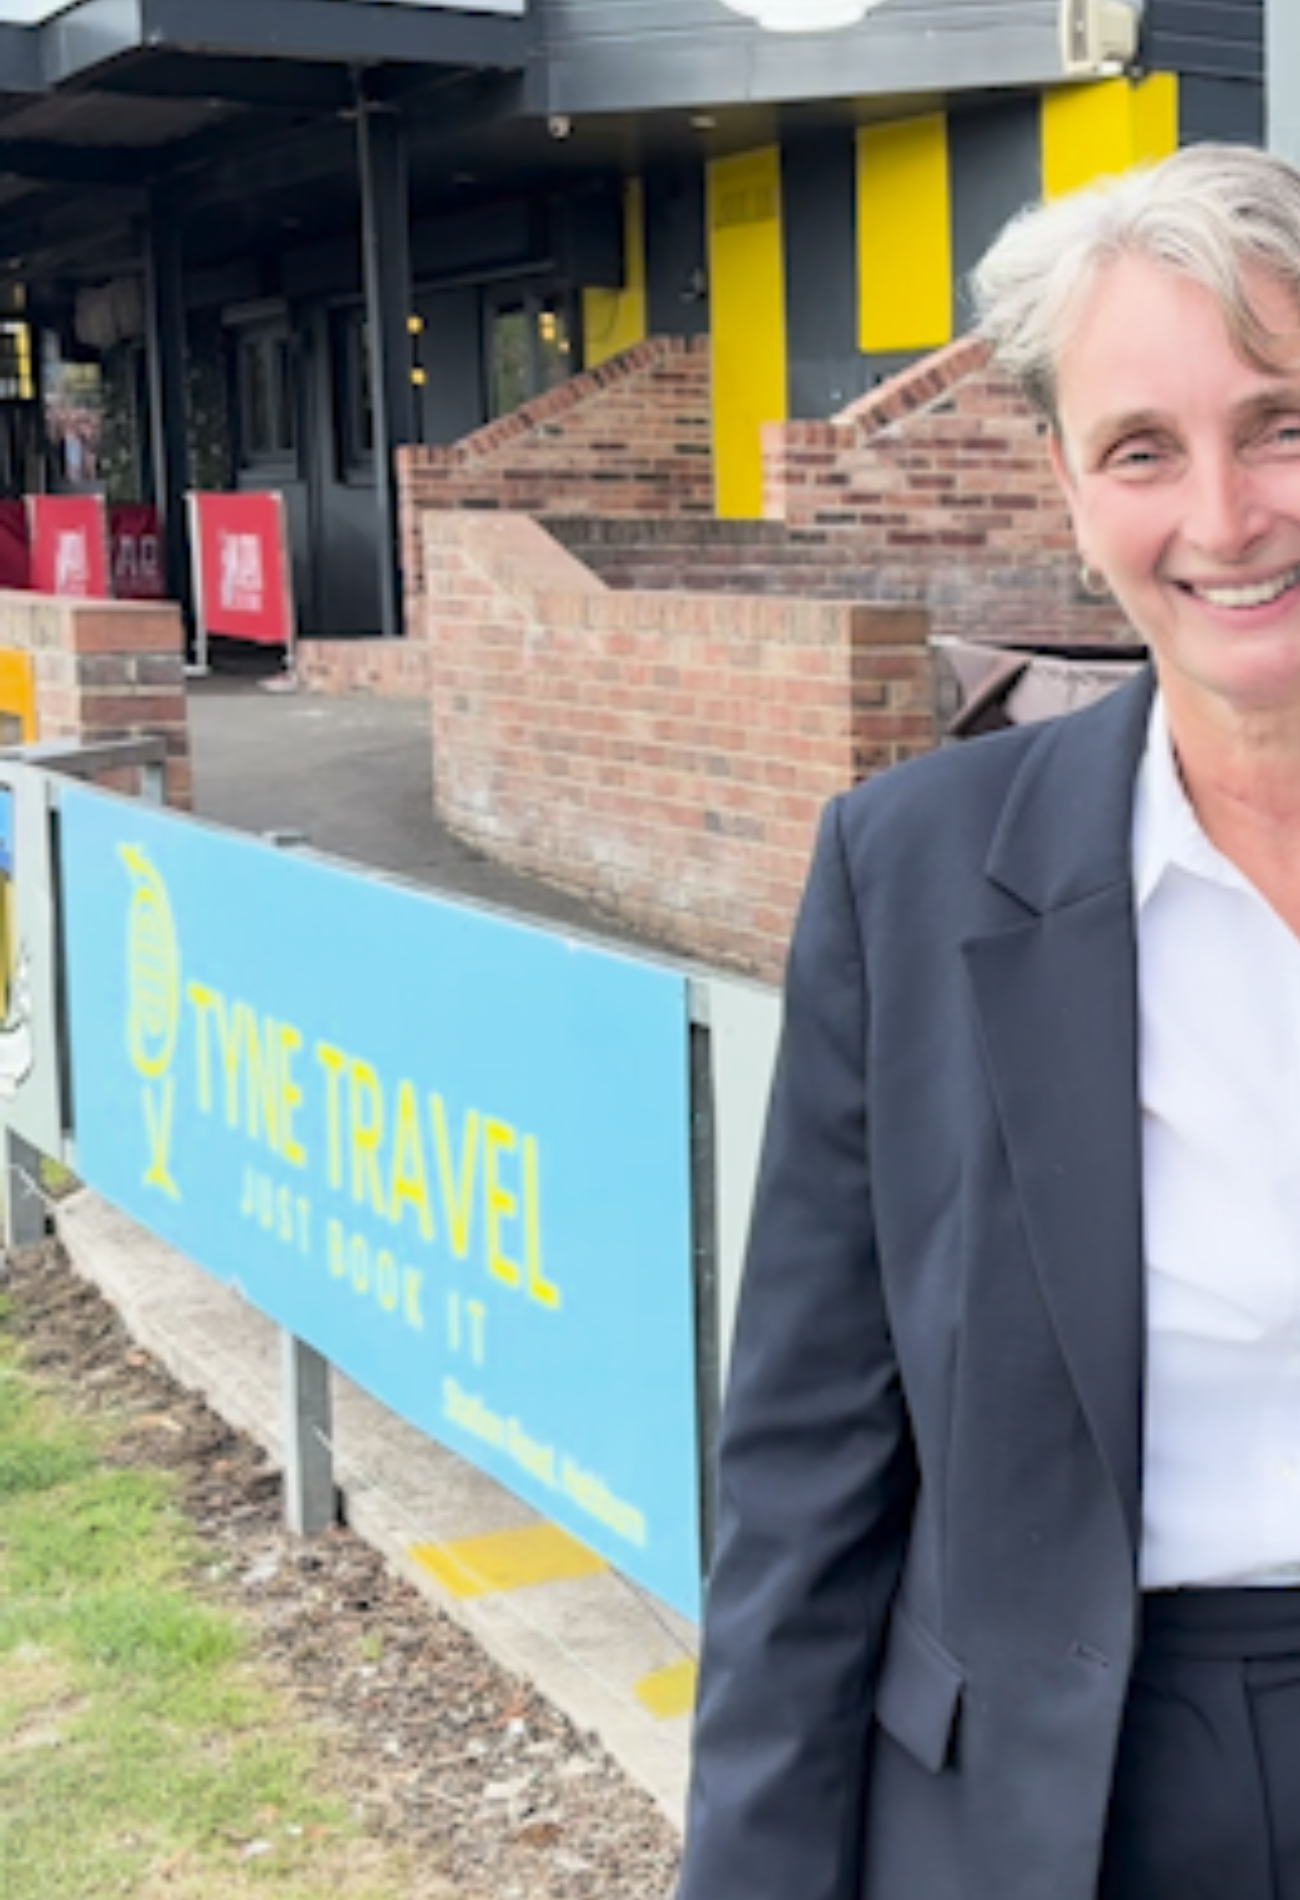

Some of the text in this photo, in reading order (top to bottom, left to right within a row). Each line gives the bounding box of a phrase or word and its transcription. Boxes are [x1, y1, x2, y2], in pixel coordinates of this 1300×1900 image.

[187, 982, 560, 1309] TYNE TRAVEL
[241, 1164, 487, 1367] JUST BOOK IT
